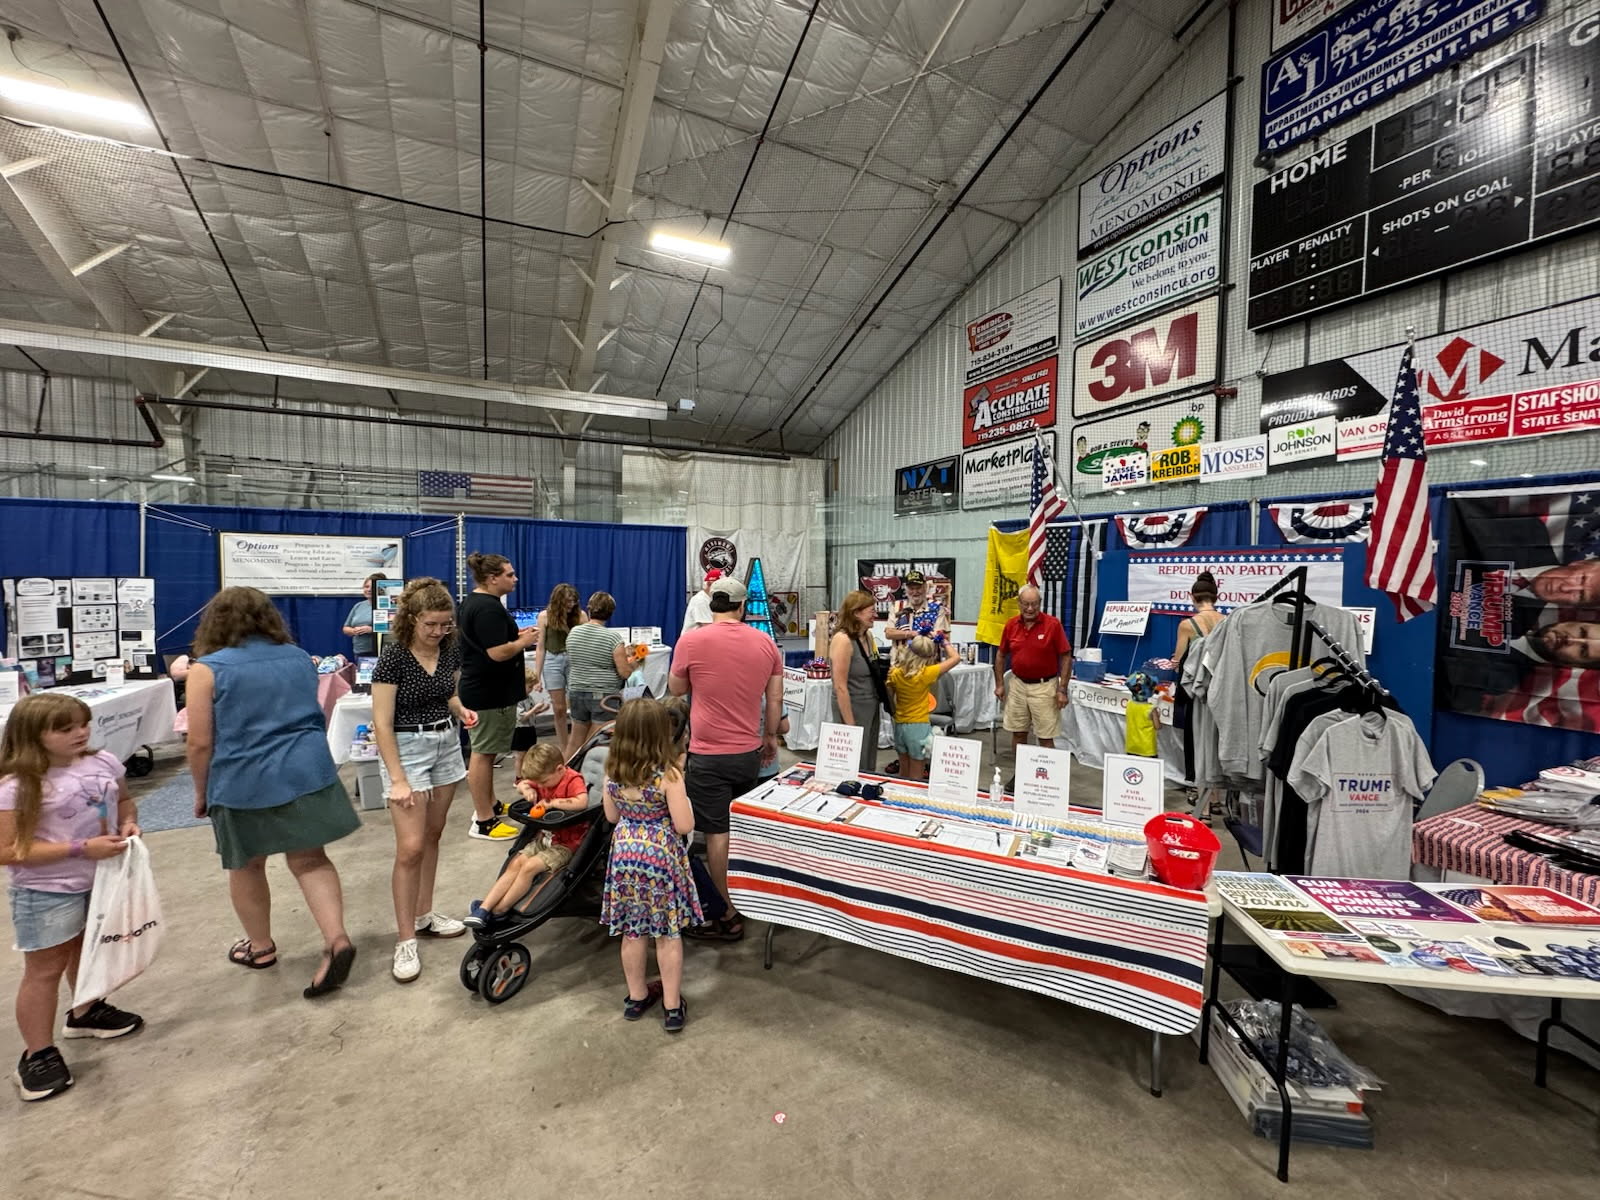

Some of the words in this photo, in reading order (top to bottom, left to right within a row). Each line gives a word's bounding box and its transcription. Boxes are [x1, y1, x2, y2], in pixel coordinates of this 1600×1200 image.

[1333, 0, 1463, 77] 715-235-
[1266, 0, 1533, 150] AJMANAGEMENT.NET
[1267, 94, 1332, 134] APPARTMENTS
[1338, 50, 1407, 95] TOWNHOMES
[1416, 13, 1470, 52] STUDENT
[1100, 120, 1203, 194] Options
[1270, 140, 1348, 194] HOME
[1089, 163, 1210, 241] MENOMONIE
[1382, 206, 1430, 235] SHOTS
[1434, 195, 1460, 214] ON
[1463, 176, 1512, 203] GOAL
[1093, 187, 1201, 249] www.optionsmenomonie.com
[1128, 250, 1167, 277] CREDIT
[1167, 231, 1209, 261] UNION
[1250, 248, 1290, 272] PLAYER
[1298, 223, 1352, 253] PENALTY
[1131, 279, 1145, 289] We
[1146, 265, 1176, 283] belong
[1078, 265, 1216, 331] www.westconsincu.org
[1088, 311, 1198, 402] 3M
[973, 382, 1050, 432] ACCURATE
[1191, 402, 1205, 412] bp
[1517, 385, 1600, 412] STAFSHO
[992, 398, 1050, 421] CONSTRUCTION
[1267, 410, 1319, 427] PROUDLY
[1433, 407, 1465, 419] David
[1423, 410, 1509, 430] Armstrong
[1521, 415, 1560, 429] STATE
[1340, 426, 1365, 438] VAN
[1434, 427, 1497, 440] ASSEMBLY
[1273, 434, 1332, 454] JOHNSON
[965, 445, 1051, 475] MarketPlae
[1160, 450, 1191, 468] ROB
[1203, 446, 1265, 474] MOSES
[1223, 462, 1264, 472] ASSEMBLY
[901, 461, 954, 491] NXT
[1104, 470, 1145, 484] JAMES
[1113, 466, 1135, 475] JESSE
[1152, 464, 1200, 480] KREIBICH
[236, 540, 279, 552] Options
[232, 557, 284, 565] MENOMONIE
[1158, 565, 1235, 576] REPUBLICAN
[1239, 565, 1287, 576] PARTY
[1106, 605, 1149, 613] REPUBLICANS
[1466, 583, 1483, 630] VANCE
[1480, 569, 1506, 647] TRUMP
[1078, 689, 1118, 706] Defend
[1338, 779, 1391, 792] TRUMP
[1349, 793, 1381, 801] VANCE
[1297, 879, 1342, 889] GUN
[1308, 887, 1384, 899] RIGHTS
[1317, 896, 1422, 908] WOMEN'S
[1332, 905, 1413, 917] RIGHTS
